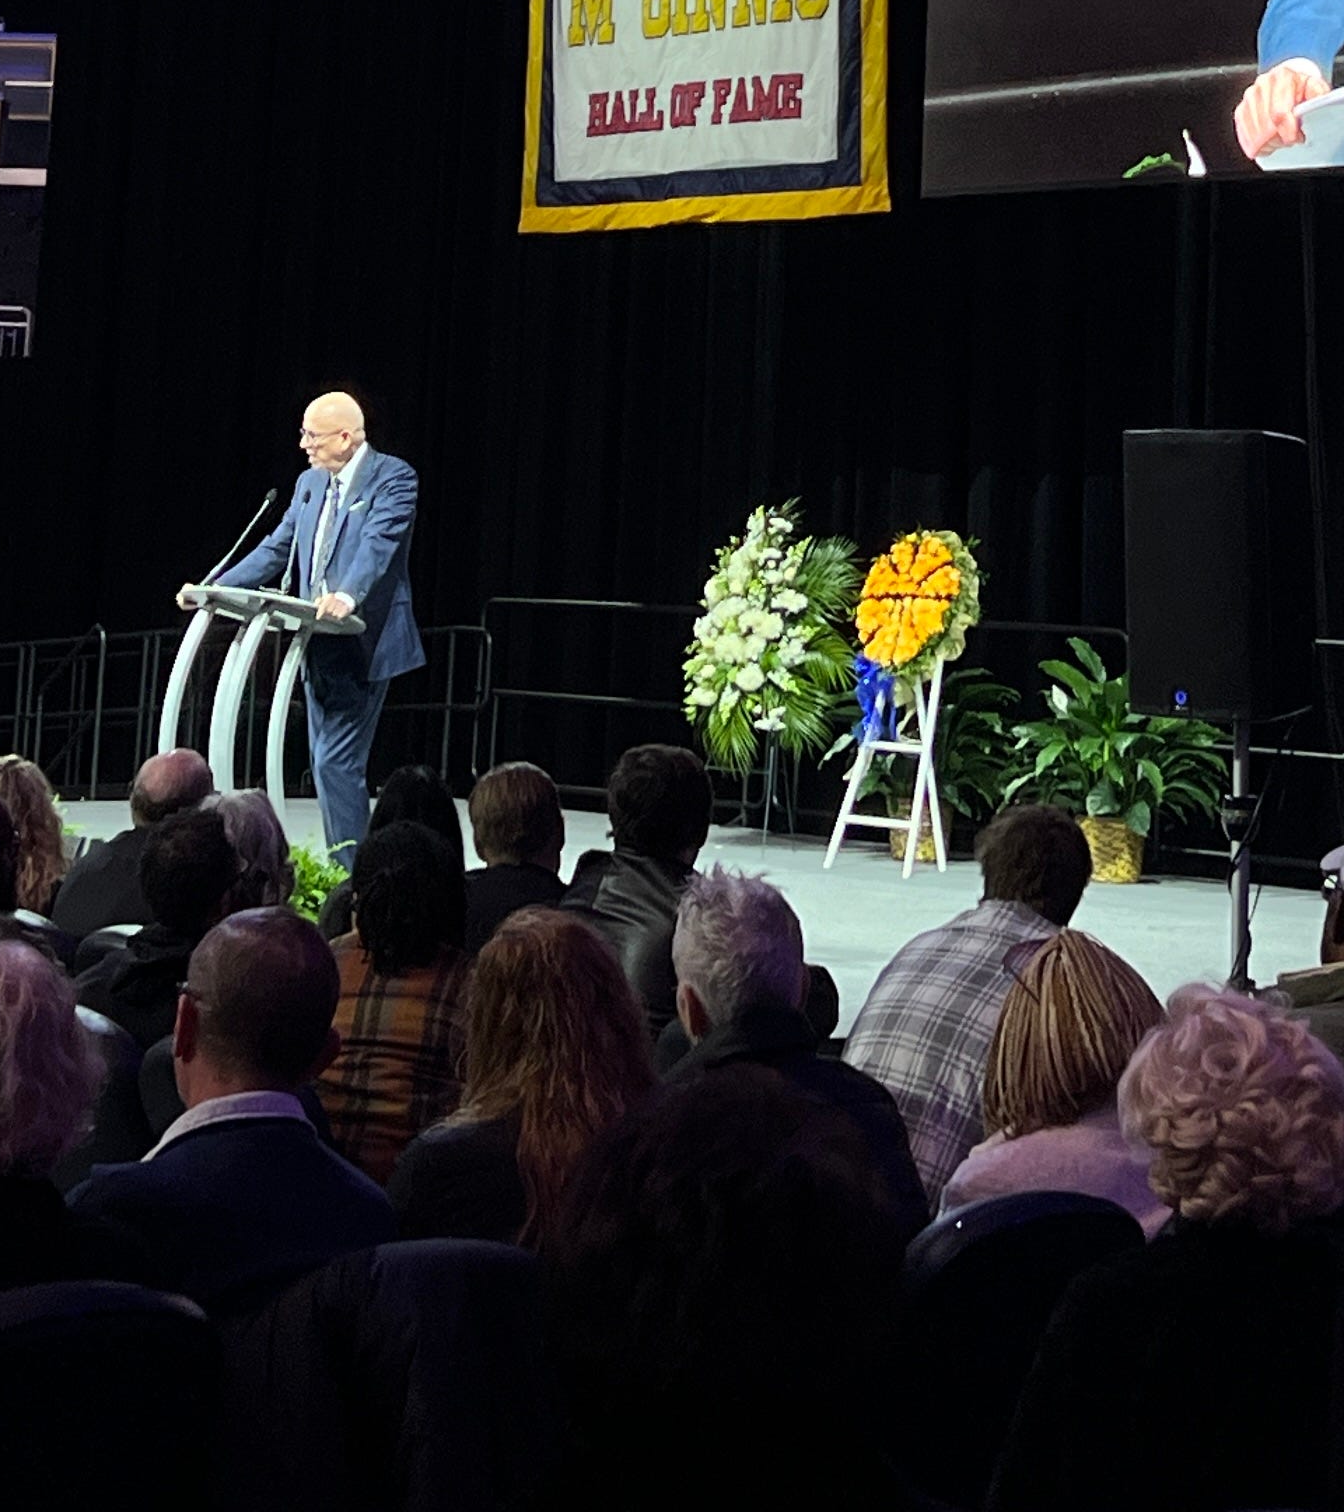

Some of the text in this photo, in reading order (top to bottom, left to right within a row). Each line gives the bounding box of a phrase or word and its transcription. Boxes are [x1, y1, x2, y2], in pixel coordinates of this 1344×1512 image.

[586, 73, 804, 138] HALL OF FAME
